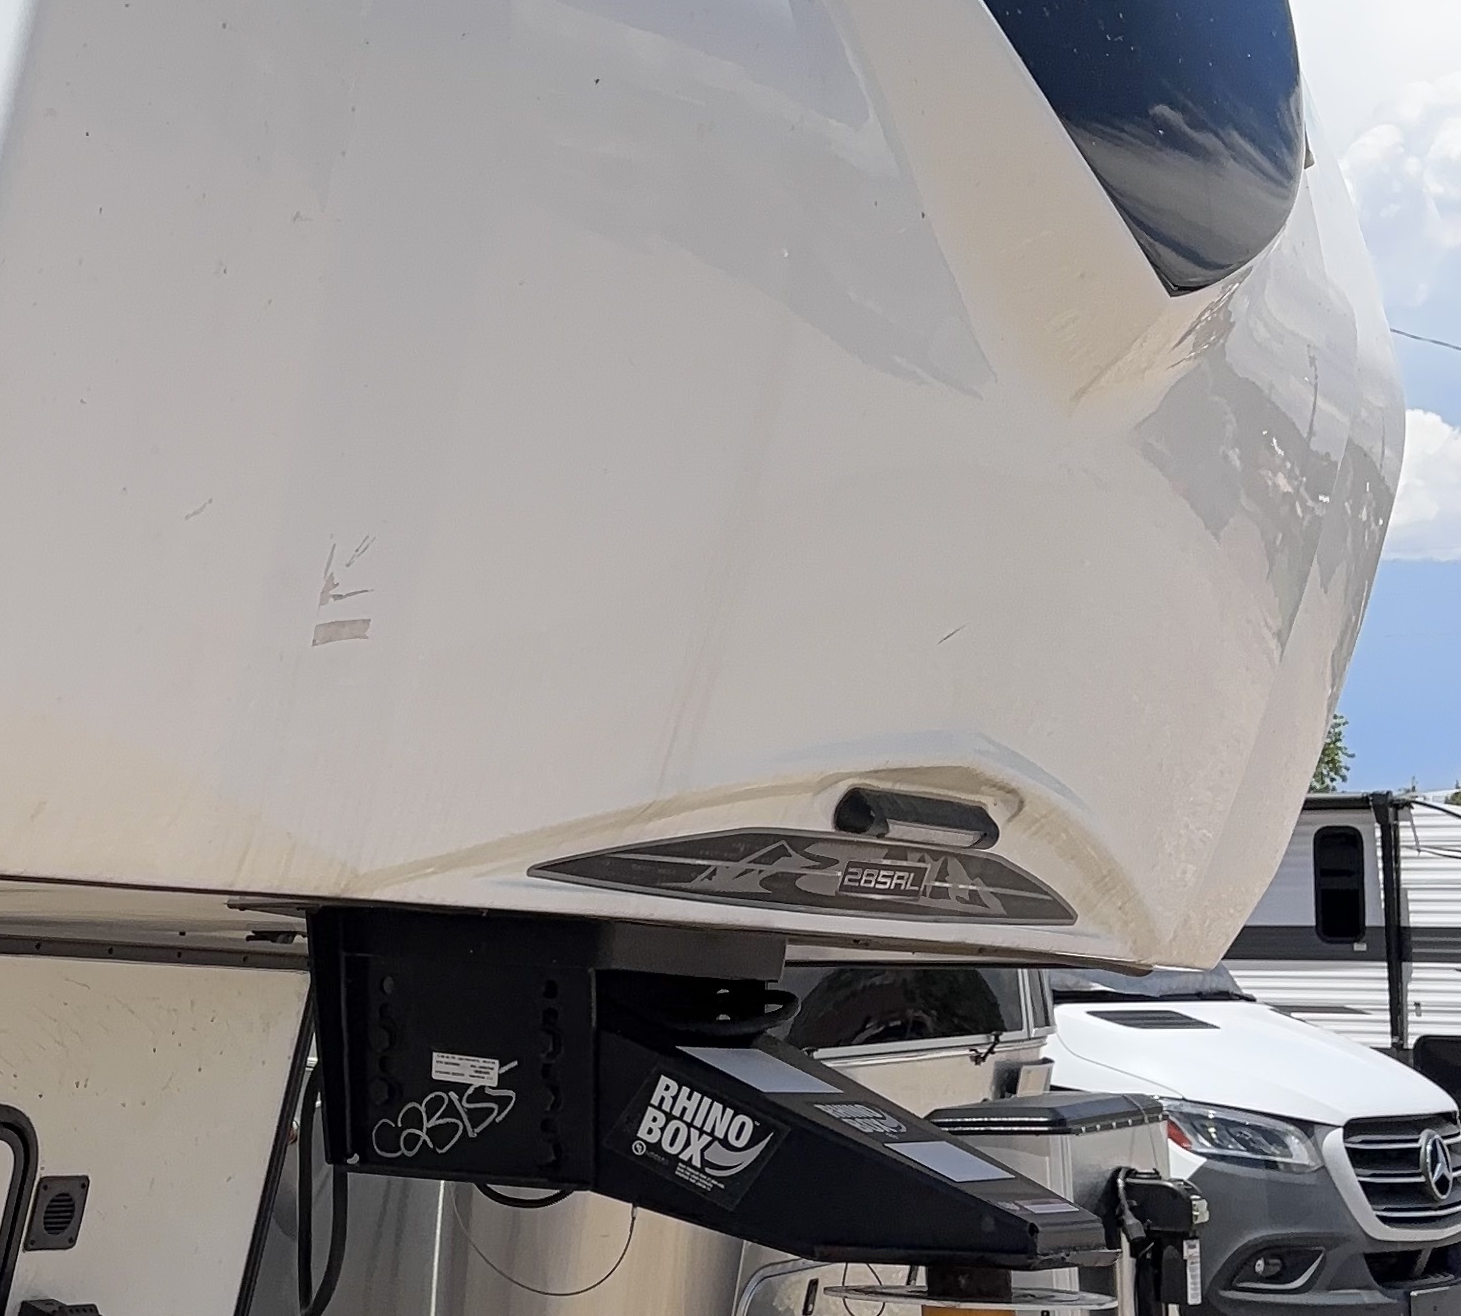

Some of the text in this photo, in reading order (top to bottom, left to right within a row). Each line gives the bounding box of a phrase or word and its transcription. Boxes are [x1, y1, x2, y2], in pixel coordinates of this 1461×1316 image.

[843, 867, 920, 891] 285RL
[636, 1105, 713, 1168] BOX
[649, 1074, 754, 1149] RHINO
